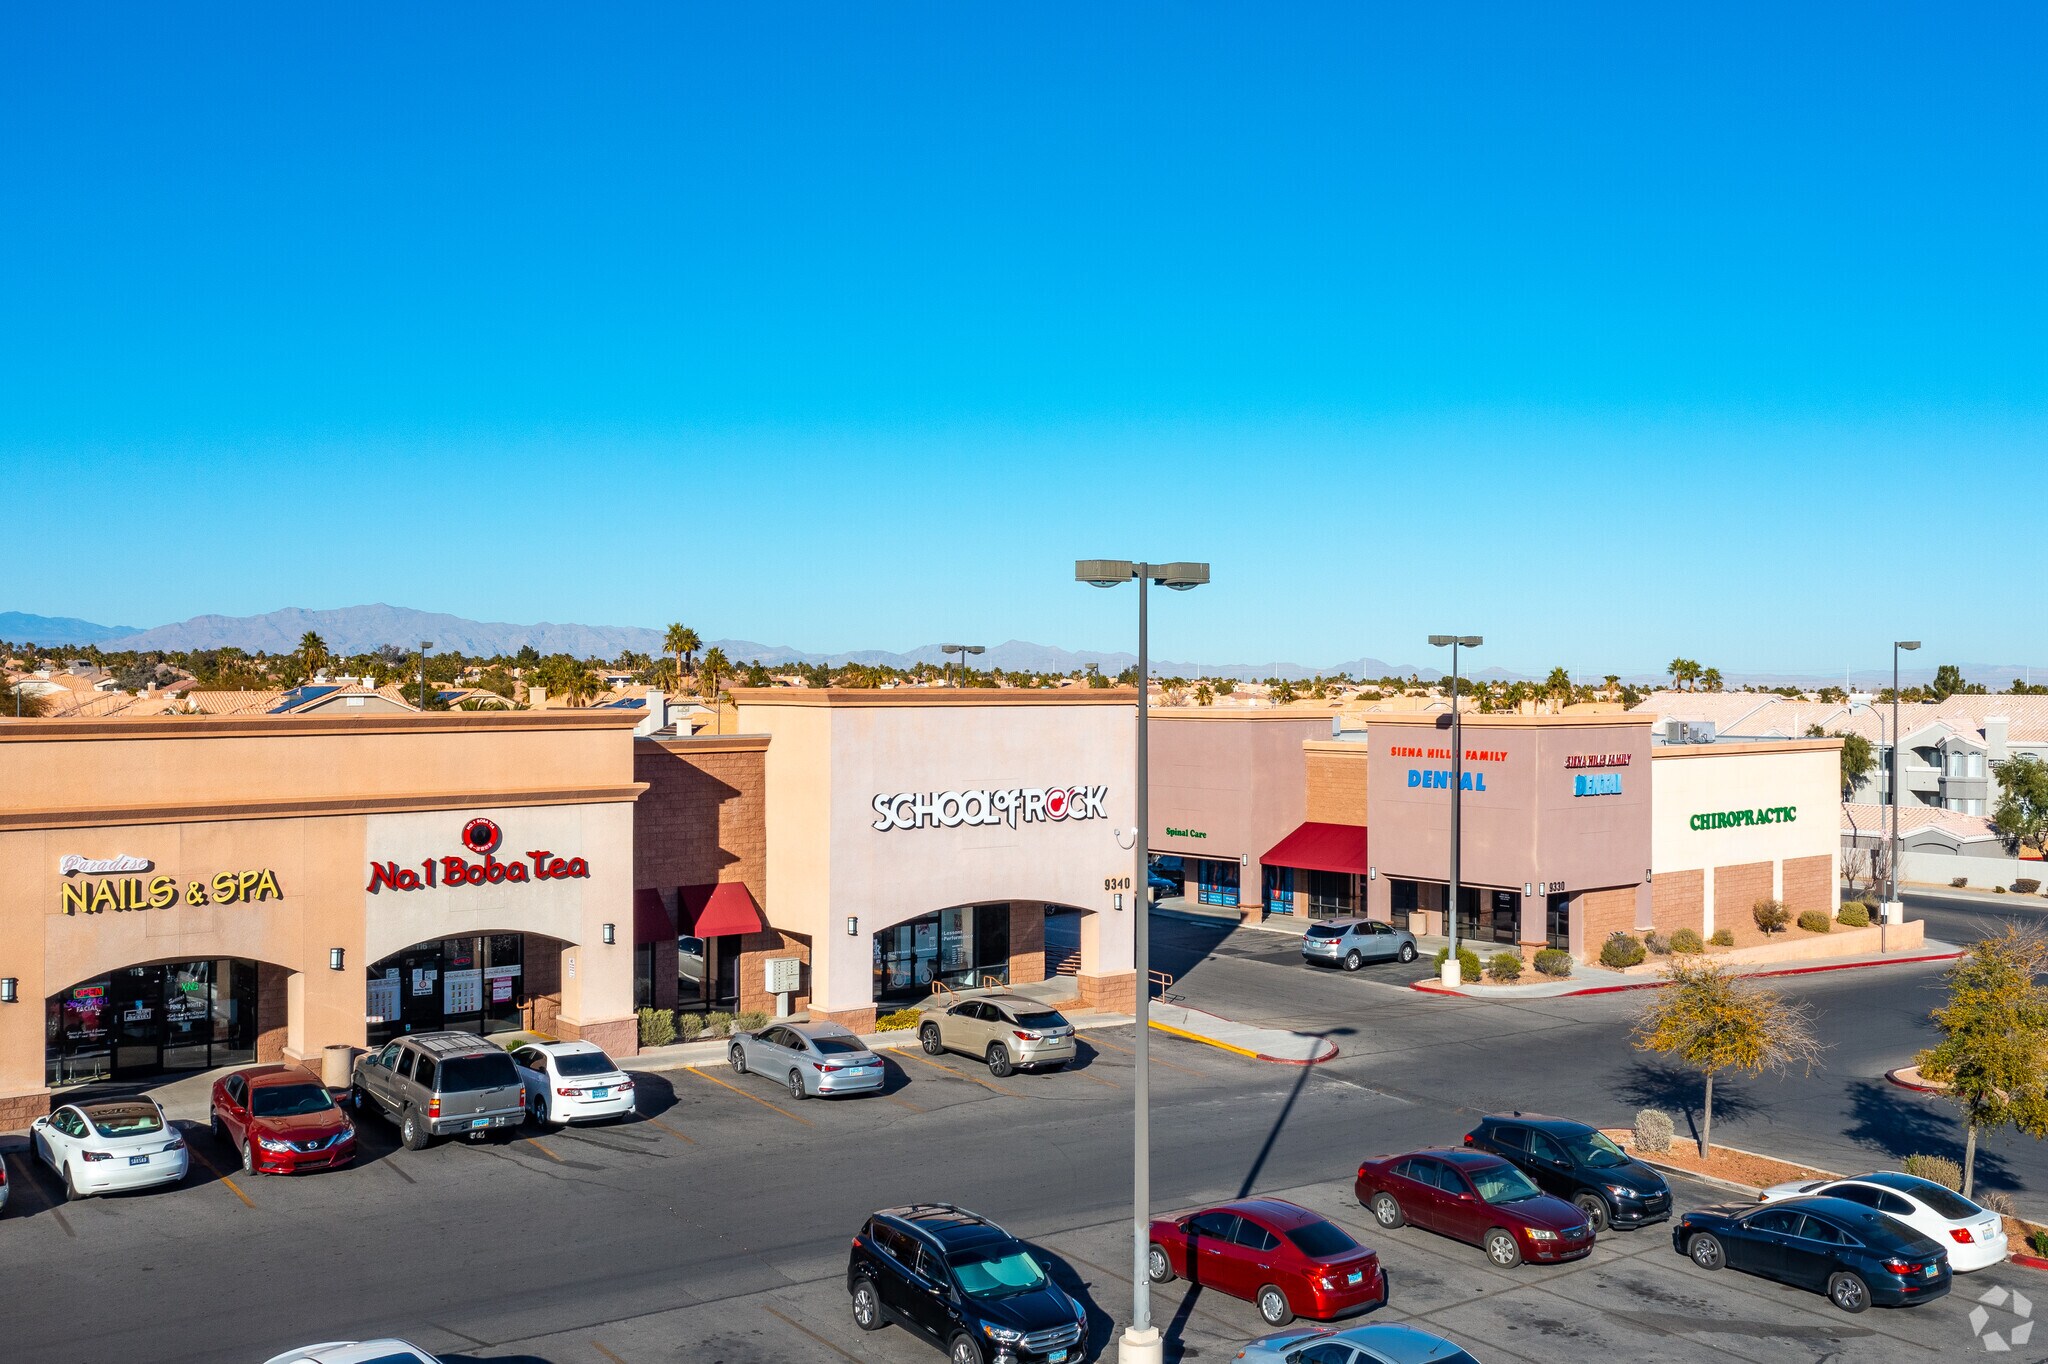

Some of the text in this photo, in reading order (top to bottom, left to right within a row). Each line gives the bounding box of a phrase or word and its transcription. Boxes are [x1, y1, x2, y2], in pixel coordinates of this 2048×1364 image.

[1391, 747, 1423, 757] SIENA
[1466, 750, 1508, 761] FAMILY
[873, 791, 1000, 832] SCHOOL
[1022, 785, 1108, 823] ROCK
[1690, 806, 1797, 831] CHIROPRACTIC
[1166, 827, 1207, 838] Spinal Care
[62, 855, 147, 872] Paradise
[440, 853, 529, 888] Boba
[527, 850, 588, 881] Tea
[1105, 877, 1130, 891] 9340
[1549, 881, 1565, 893] 9330
[62, 868, 279, 915] NAILS & SPA
[130, 968, 144, 976] 115
[75, 988, 103, 998] OPEN
